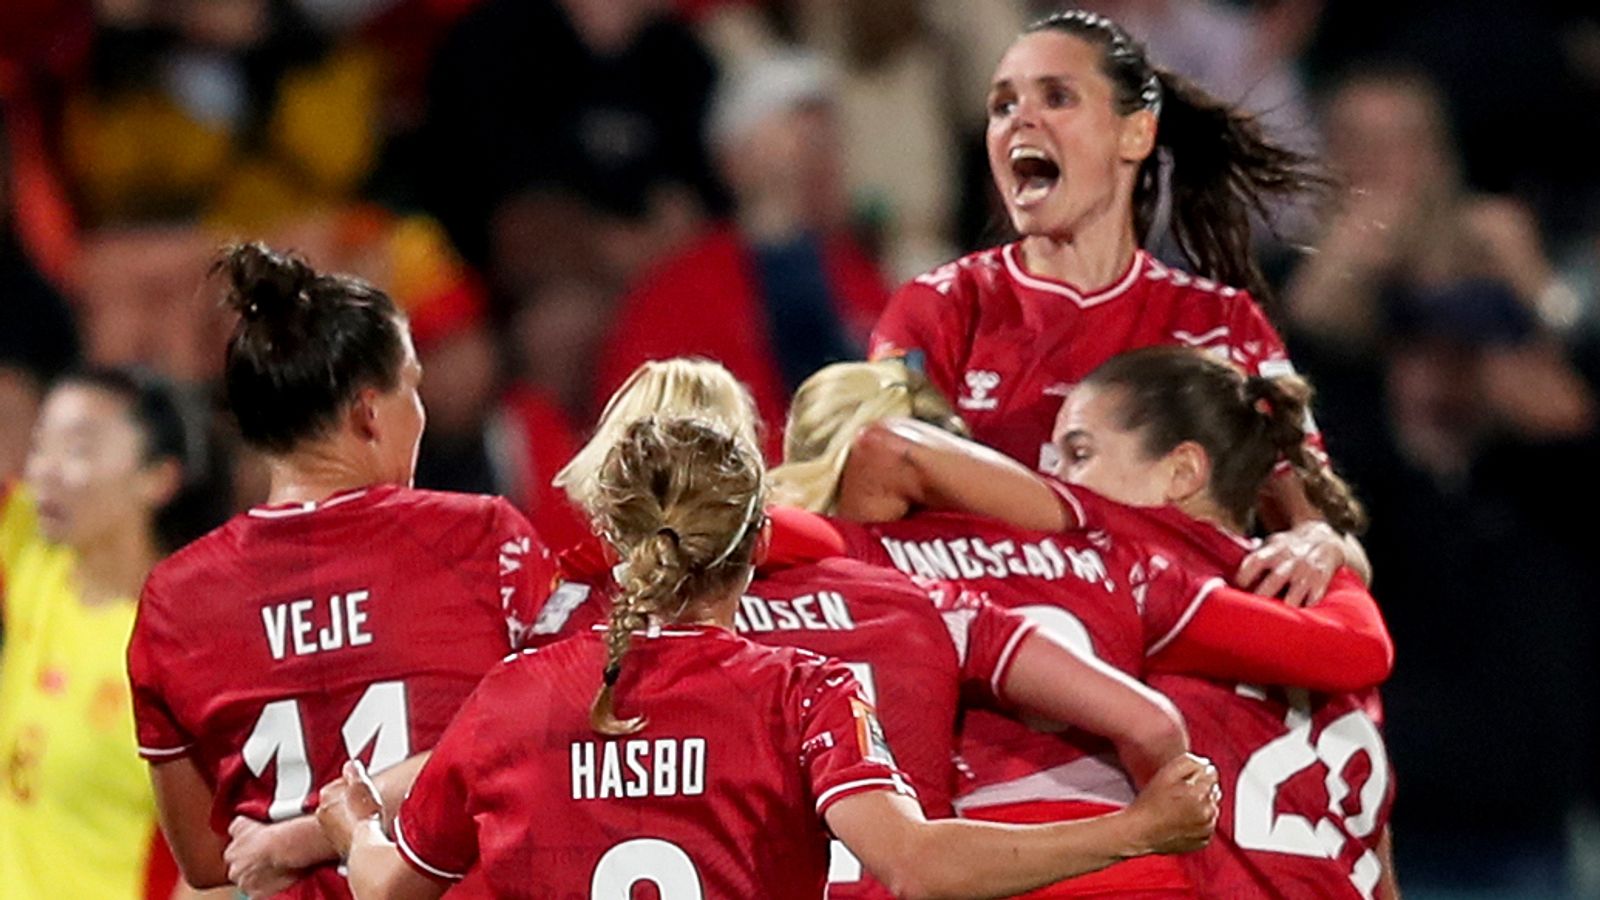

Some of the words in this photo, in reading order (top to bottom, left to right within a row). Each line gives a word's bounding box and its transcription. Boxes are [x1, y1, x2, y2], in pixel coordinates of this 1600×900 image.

[262, 590, 373, 660] VEJE
[242, 681, 409, 821] 11
[571, 738, 706, 799] HASBO
